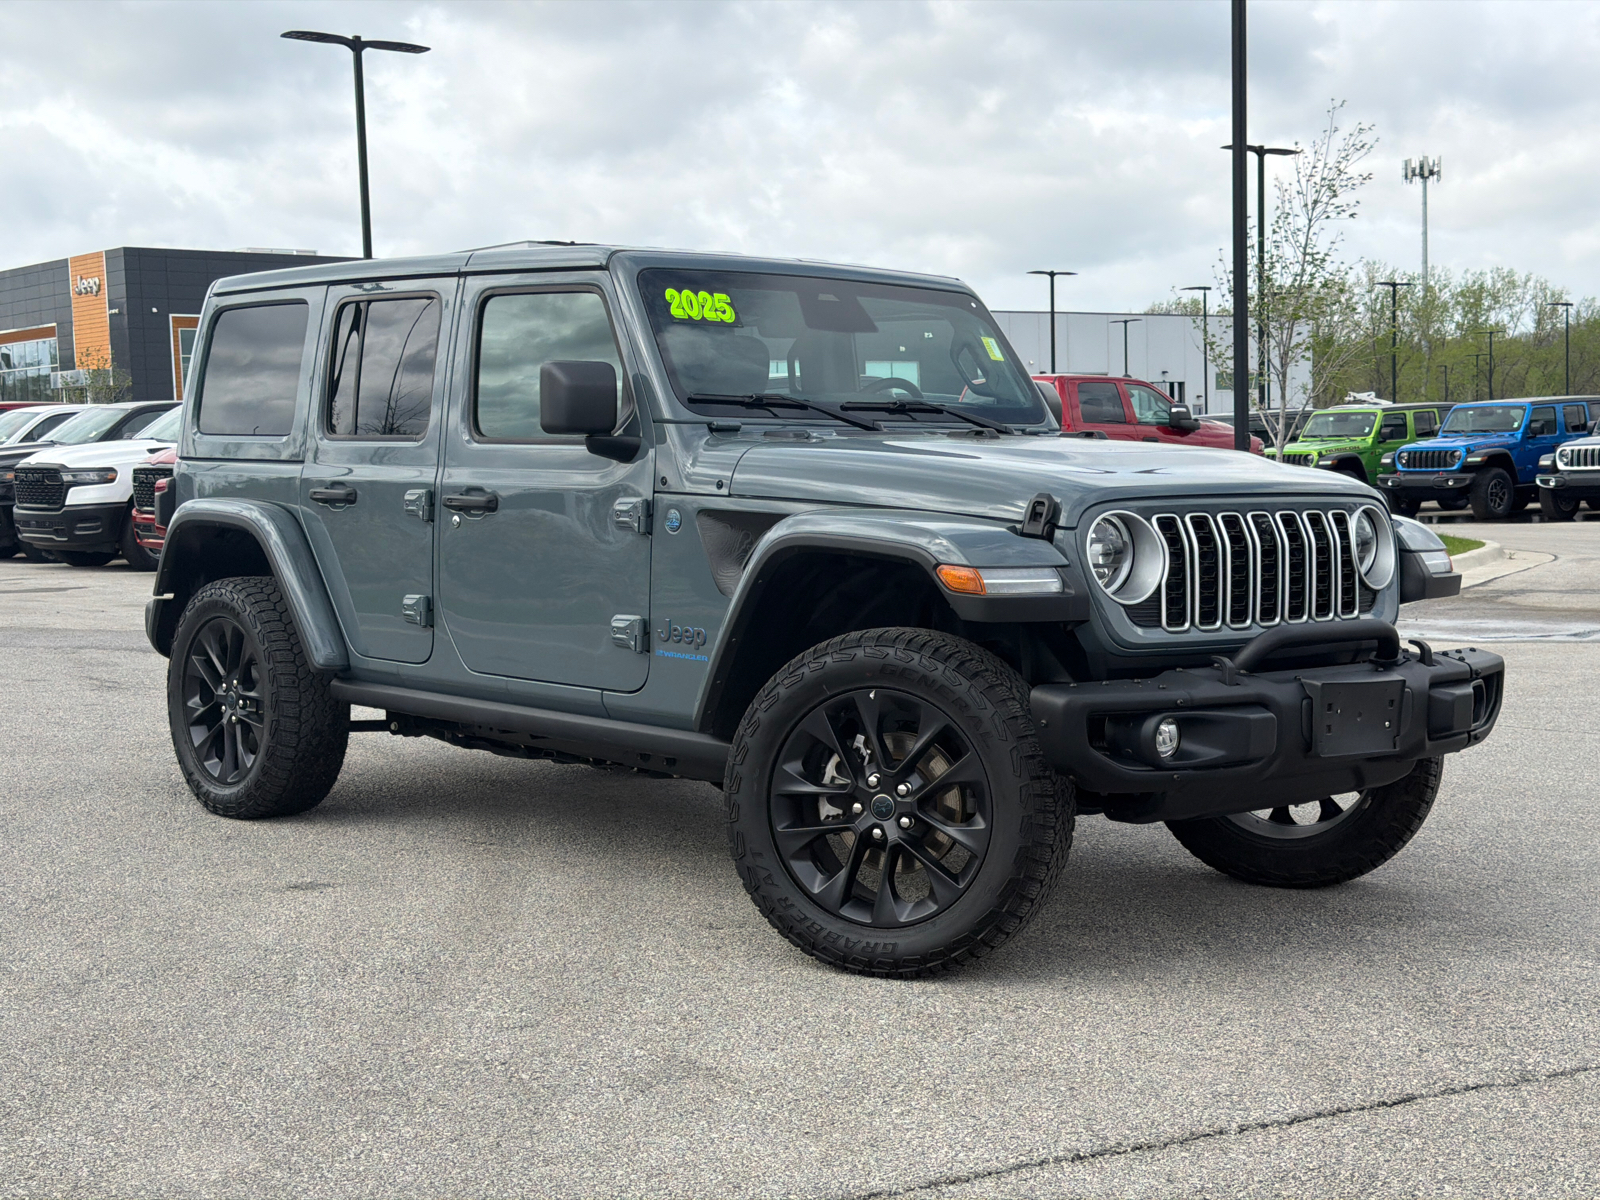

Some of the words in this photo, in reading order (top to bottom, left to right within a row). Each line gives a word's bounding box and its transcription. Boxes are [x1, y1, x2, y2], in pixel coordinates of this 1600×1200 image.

[75, 275, 100, 297] Jeep
[665, 288, 736, 323] 2025
[19, 473, 43, 482] RAM
[657, 618, 707, 650] Jeep
[663, 651, 708, 662] WRANGLER
[879, 664, 993, 748] GENERAL
[776, 896, 899, 954] GRABBER
